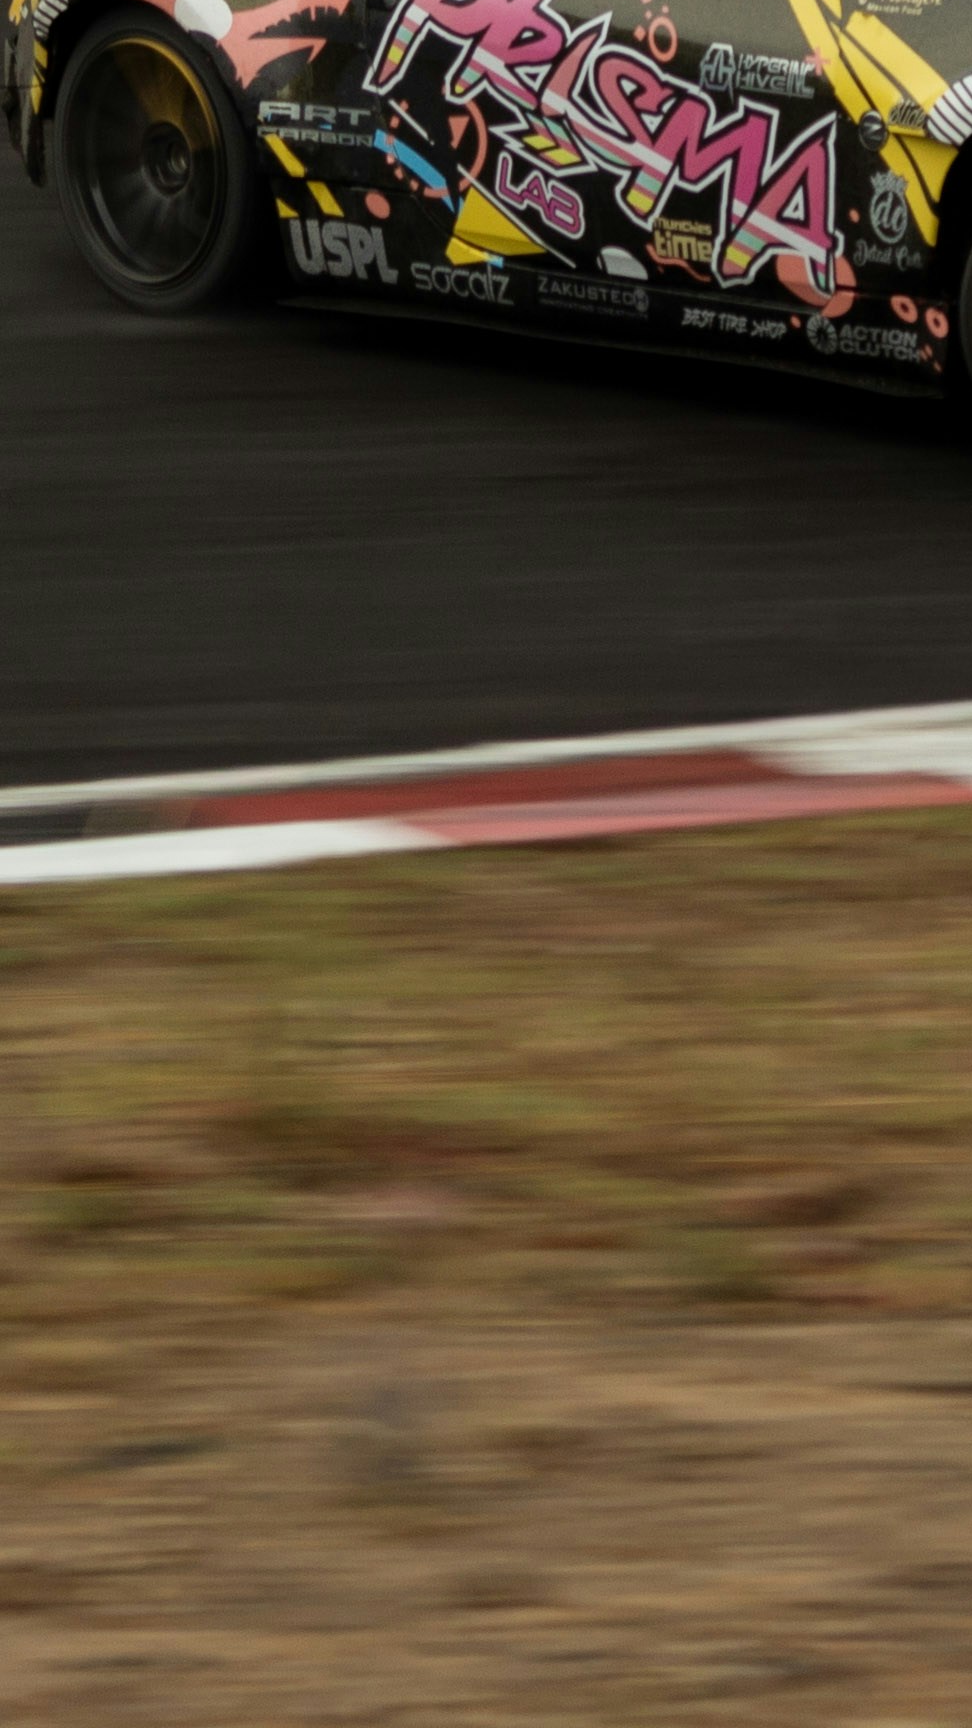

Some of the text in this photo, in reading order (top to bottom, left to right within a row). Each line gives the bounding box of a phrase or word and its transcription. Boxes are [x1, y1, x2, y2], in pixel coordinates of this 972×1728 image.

[258, 100, 371, 125] ART
[257, 126, 373, 148] CARBON
[496, 150, 585, 240] LAB
[289, 219, 399, 285] USPL
[840, 324, 918, 347] ACTION
[838, 339, 920, 363] CLUTCH
